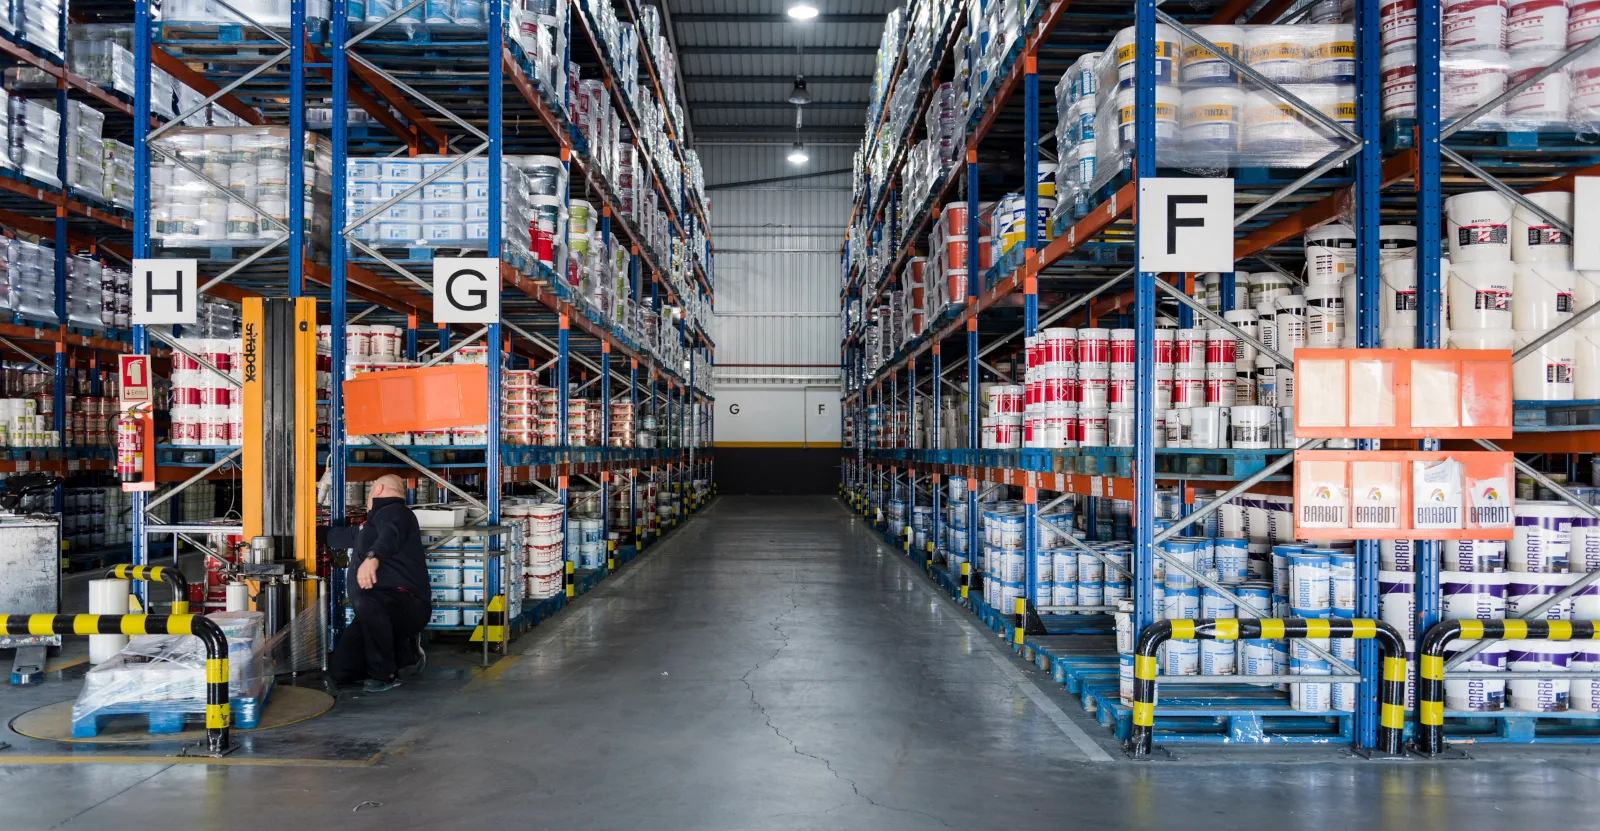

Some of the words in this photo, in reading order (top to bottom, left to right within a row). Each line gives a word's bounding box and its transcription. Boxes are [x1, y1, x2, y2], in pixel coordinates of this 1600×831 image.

[1330, 45, 1355, 54] TINTAS
[1204, 108, 1229, 117] TINTAS
[1167, 194, 1208, 255] F
[146, 270, 183, 313] H
[445, 268, 488, 312] G
[1263, 326, 1272, 348] ARBOT
[729, 403, 740, 415] G
[818, 404, 826, 415] F
[1303, 505, 1344, 523] BARBOT
[1356, 506, 1397, 523] BARBOT
[1417, 506, 1458, 524] BARBOT
[1470, 506, 1511, 523] BARBOT
[1395, 539, 1410, 572] BARBO
[1459, 539, 1474, 572] BARBO
[1527, 533, 1541, 573] BARBOT
[1300, 578, 1311, 608] BARBOT
[1184, 607, 1193, 619] BOT
[1477, 601, 1491, 620] BOT
[1306, 683, 1318, 710] BARBO
[1468, 679, 1484, 709] BARB
[1538, 679, 1553, 709] BARB
